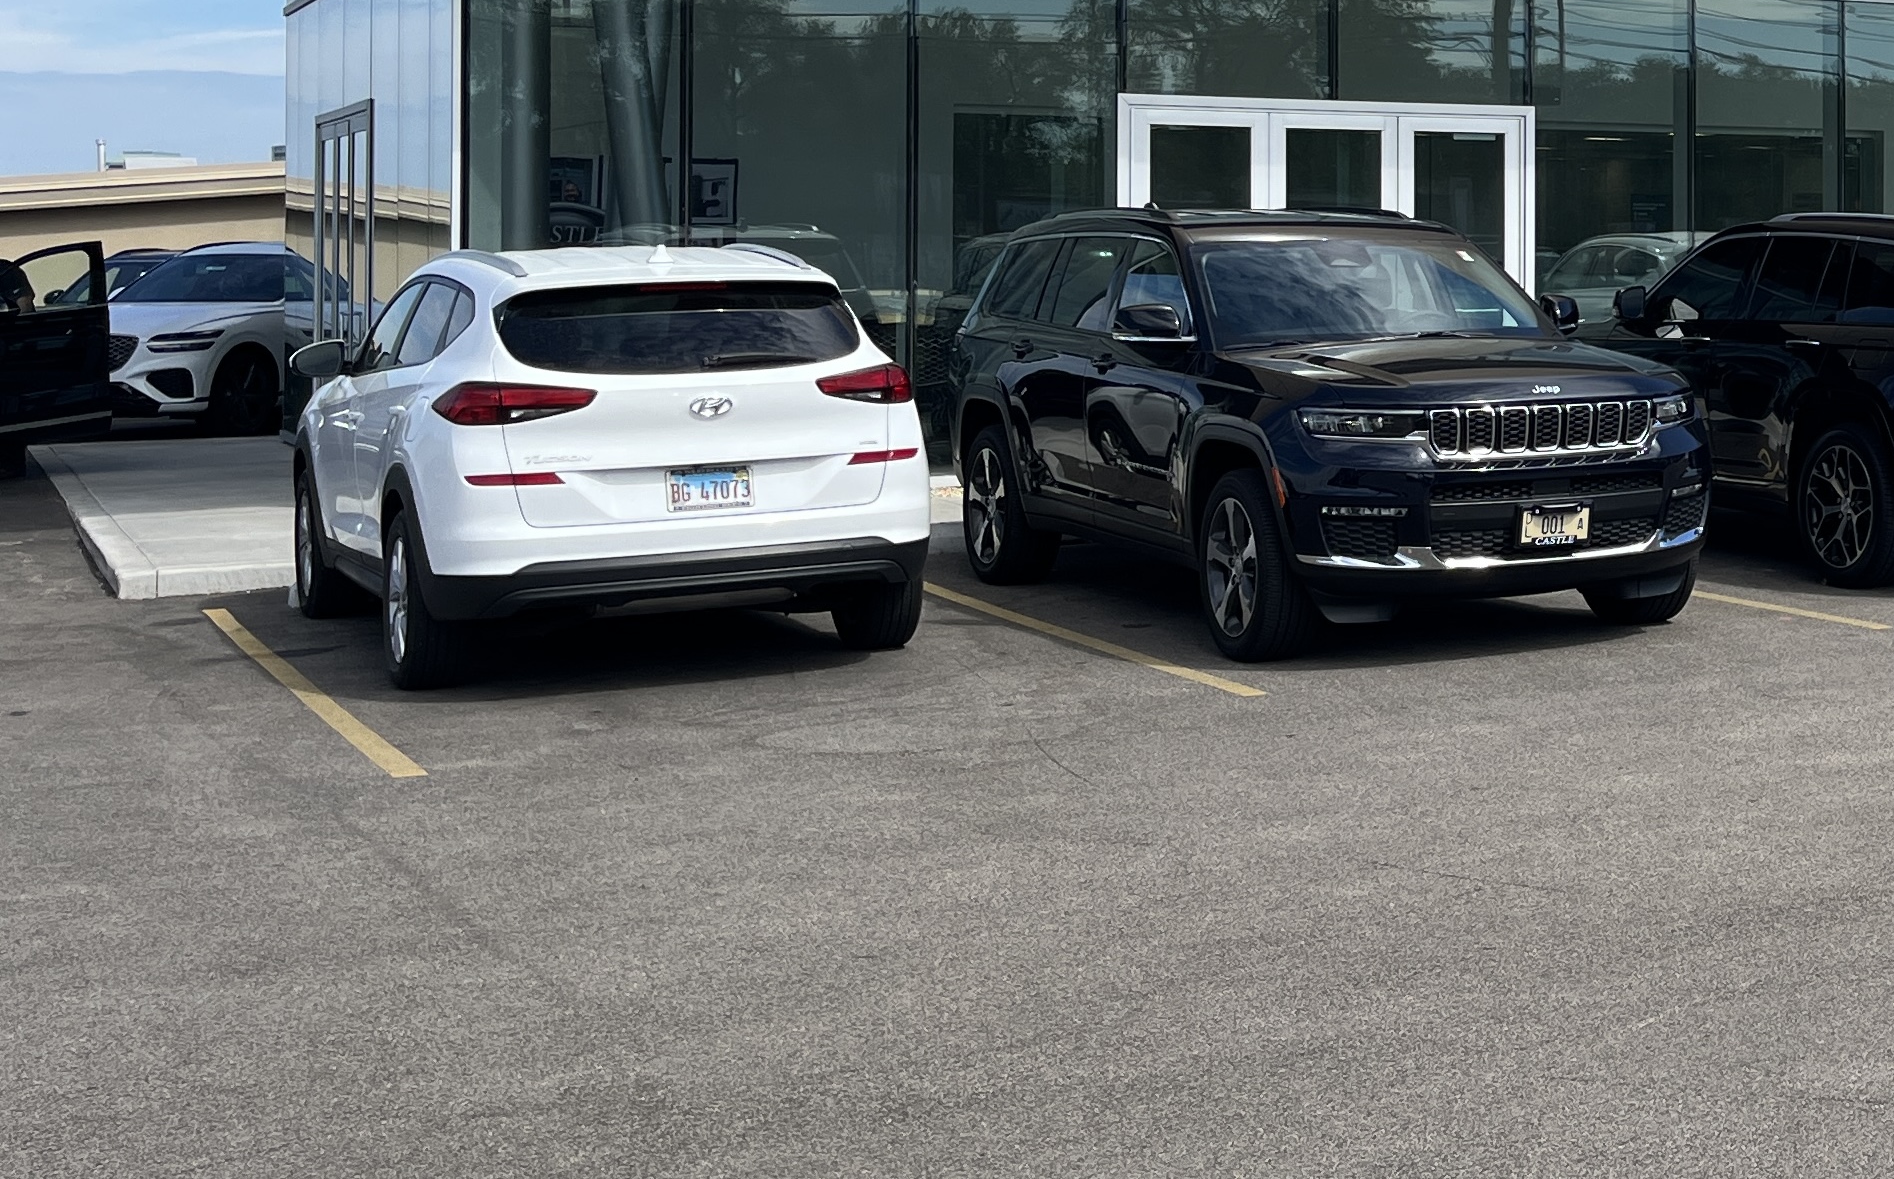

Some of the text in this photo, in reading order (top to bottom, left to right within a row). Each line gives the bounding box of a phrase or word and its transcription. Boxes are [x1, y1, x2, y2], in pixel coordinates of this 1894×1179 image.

[1532, 384, 1561, 394] Jeep
[671, 479, 750, 503] BG 47073
[1541, 515, 1584, 534] 001 A
[1535, 535, 1576, 545] CASTLE
